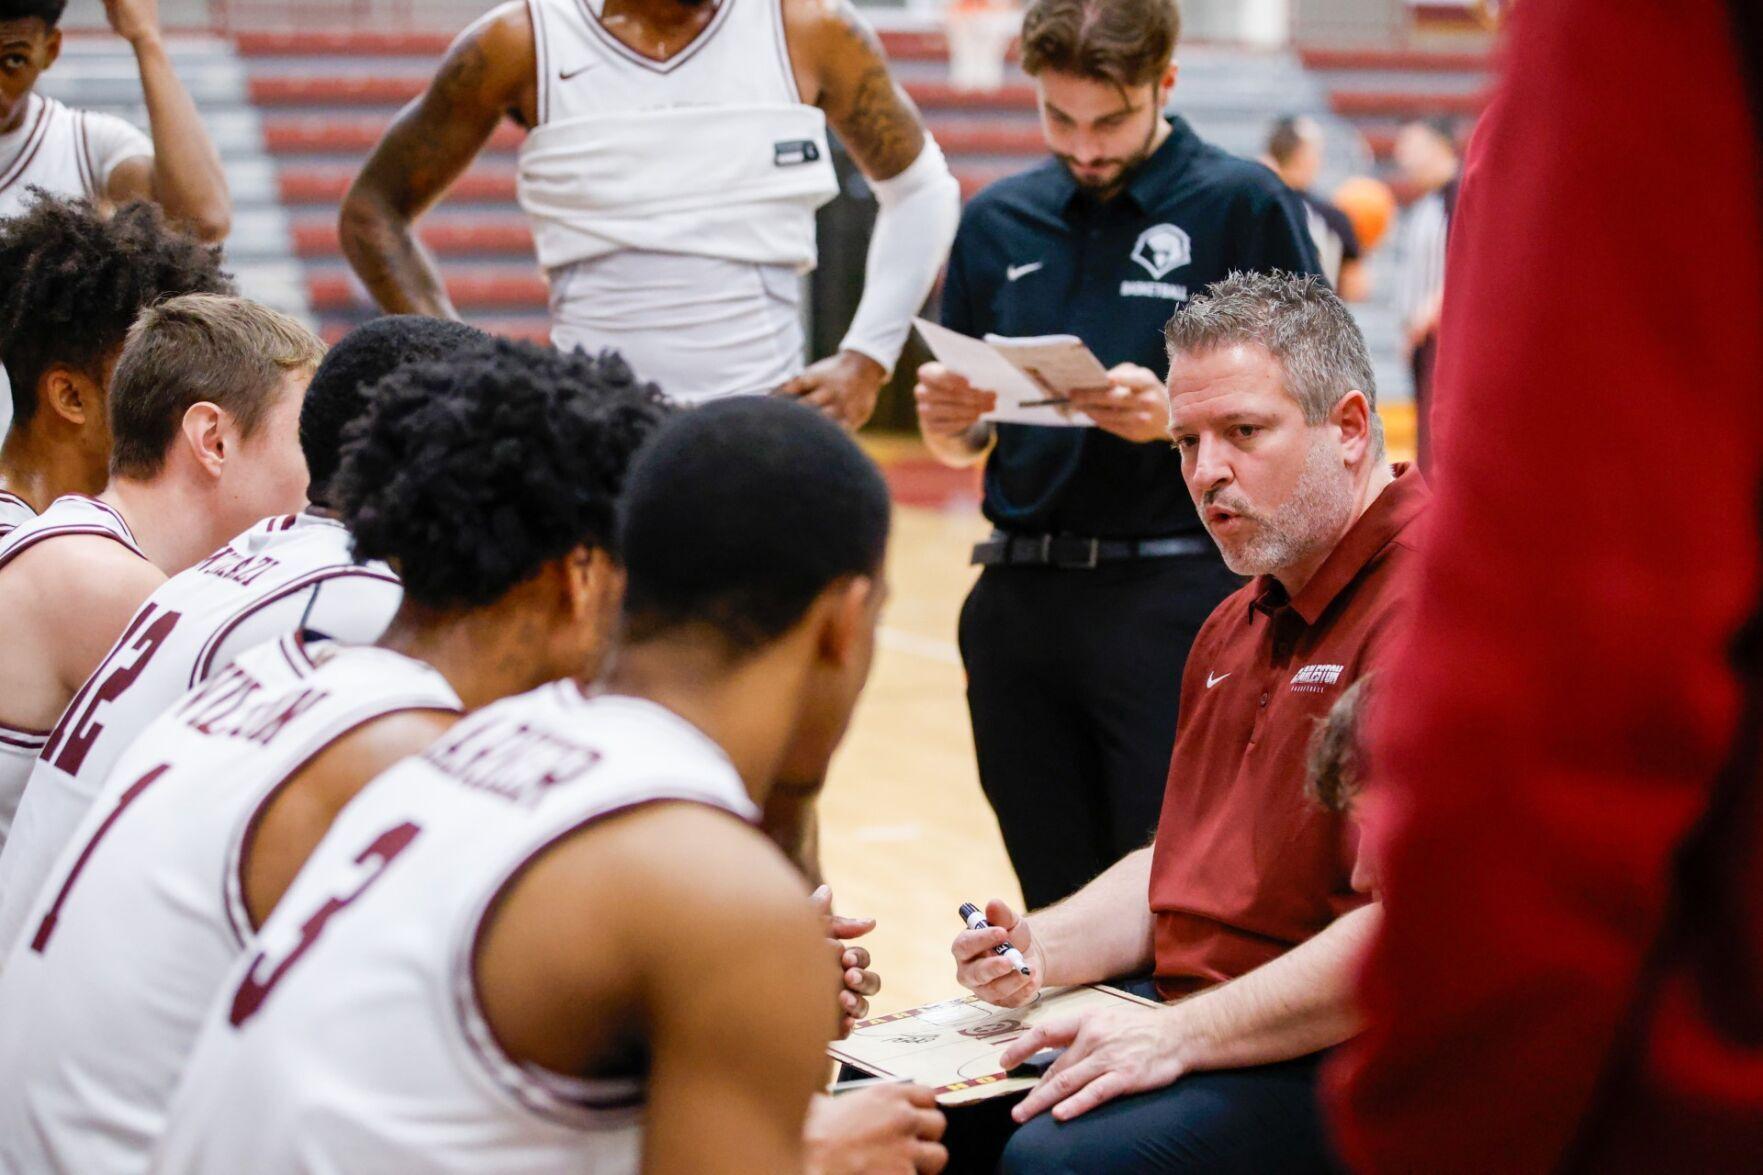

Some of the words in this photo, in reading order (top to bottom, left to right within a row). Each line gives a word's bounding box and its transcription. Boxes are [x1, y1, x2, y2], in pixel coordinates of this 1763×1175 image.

[39, 602, 182, 777] 12
[31, 763, 173, 954] 1
[229, 821, 421, 1028] 3
